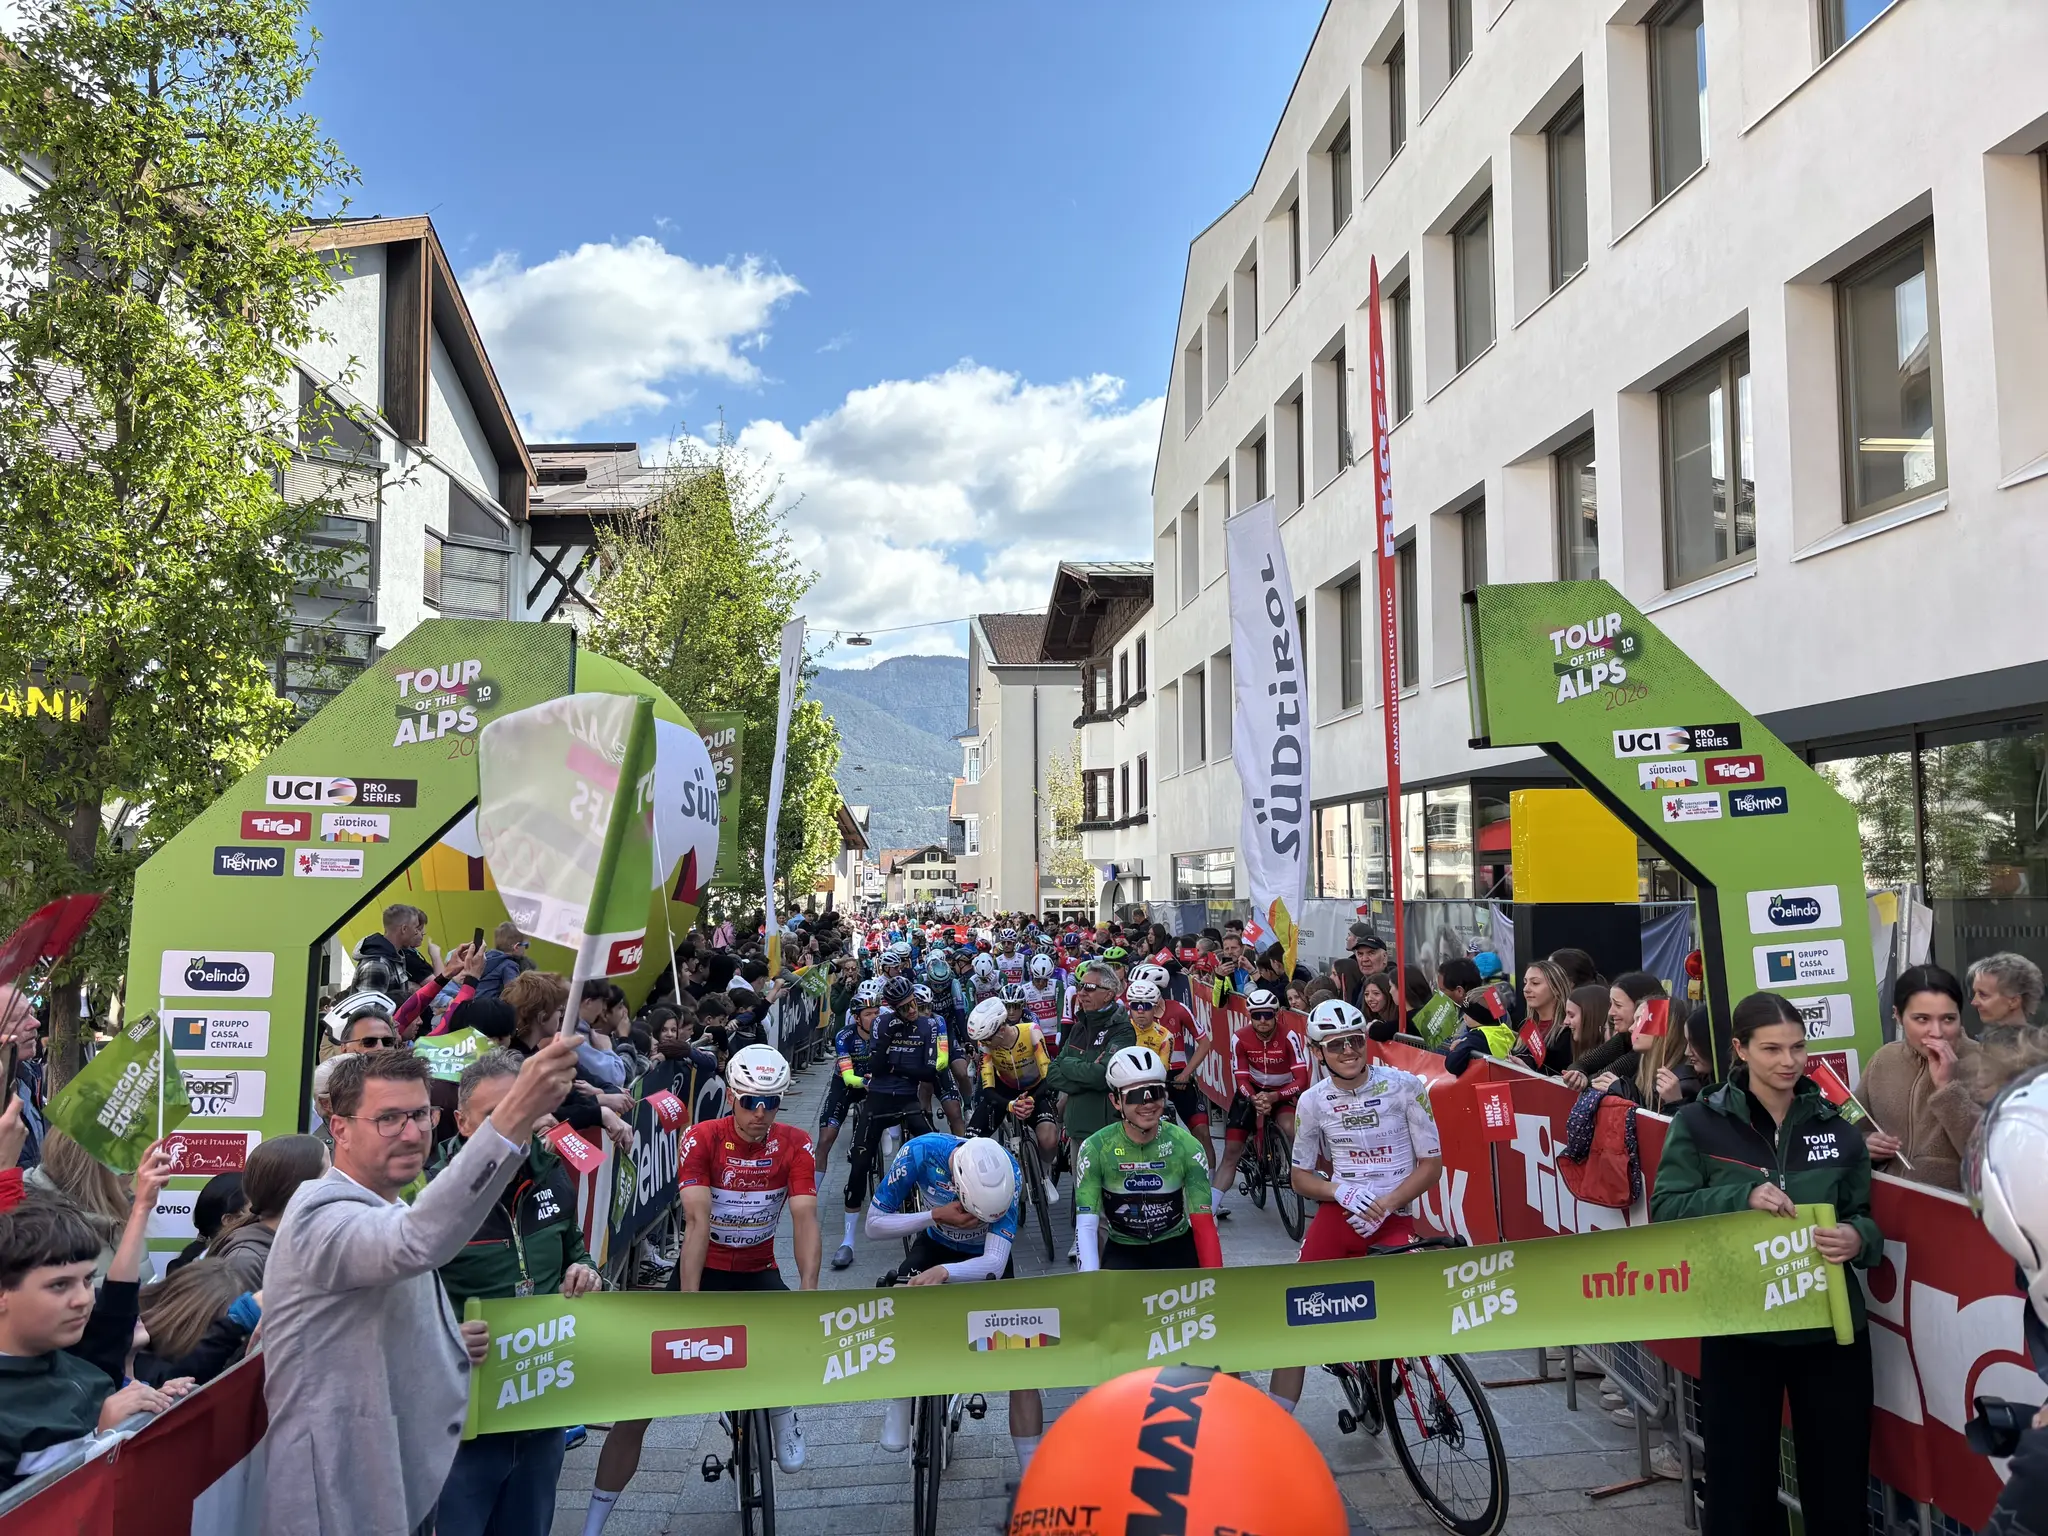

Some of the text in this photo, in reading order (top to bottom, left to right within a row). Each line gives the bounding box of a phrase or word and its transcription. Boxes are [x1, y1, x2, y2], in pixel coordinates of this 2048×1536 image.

[1550, 612, 1622, 656] TOUR
[1621, 637, 1633, 648] 10
[1570, 648, 1605, 667] OF THE
[396, 660, 482, 698] TOUR
[1556, 656, 1626, 704] ALPS
[477, 686, 491, 697] 10
[1605, 681, 1648, 711] 2026
[416, 694, 457, 711] OF THE
[393, 705, 478, 748] ALPS
[1695, 729, 1714, 738] PRO
[703, 728, 736, 750] OUR
[1618, 732, 1661, 752] UCI
[1696, 737, 1728, 748] SERIES
[448, 737, 476, 760] 20
[1649, 764, 1687, 775] SÜDtiROL
[1714, 762, 1756, 778] Tirol
[272, 781, 322, 800] UCI
[363, 783, 387, 793] PRO
[363, 792, 401, 803] SERIES
[1735, 796, 1782, 812] TRENTINO
[252, 818, 302, 836] Tirol
[334, 816, 378, 828] SÜDtiROL
[221, 855, 278, 871] TRENTINO
[1770, 902, 1819, 918] Melinda
[619, 947, 643, 965] Tiro
[1798, 950, 1828, 958] GRUPPO
[1800, 960, 1822, 968] CASSA
[1800, 968, 1835, 978] CENTRALE
[188, 968, 246, 982] Melinda
[212, 1020, 249, 1028] GRUPPO
[426, 1036, 477, 1058] TOUR
[429, 1064, 470, 1074] ALP
[1248, 1056, 1284, 1064] AUSTRIA
[97, 1062, 141, 1128] EUREGIO
[186, 1082, 232, 1095] FORST
[661, 1098, 678, 1122] BRUCK
[1484, 1103, 1494, 1128] INNS'
[1491, 1095, 1504, 1126] BRUCK
[1502, 1103, 1510, 1126] REGION
[1344, 1116, 1374, 1126] FORST
[185, 1138, 246, 1146] CAFFÈ ITALIANO
[562, 1136, 588, 1160] BRUCK
[568, 1132, 589, 1150] INNS'
[1158, 1140, 1172, 1150] TOUR
[1803, 1134, 1836, 1145] TOUR
[764, 1146, 779, 1156] ALPS
[1158, 1148, 1172, 1158] ALPS
[1807, 1148, 1840, 1162] ALPS
[888, 1166, 908, 1186] ALPS
[1126, 1178, 1162, 1188] Melinda
[533, 1188, 554, 1200] TOUR
[156, 1205, 190, 1214] eviso
[538, 1203, 561, 1221] ALPS
[1141, 1200, 1174, 1211] ANEST
[1145, 1206, 1174, 1219] IWATA
[1443, 1249, 1514, 1290] TOUR
[1776, 1257, 1810, 1276] OF THE
[1142, 1278, 1216, 1317] TOUR
[1462, 1280, 1497, 1300] OF THE
[1764, 1266, 1828, 1312] ALPS
[1294, 1293, 1368, 1318] TRENTINO
[1451, 1288, 1518, 1335] ALPS
[819, 1296, 894, 1338] TOUR
[984, 1313, 1044, 1328] SÜDtiROL
[1161, 1307, 1197, 1326] OF THE
[495, 1314, 577, 1361] TOUR
[839, 1328, 876, 1348] OF THE
[1146, 1314, 1217, 1360] ALPS
[666, 1336, 733, 1362] Tirol
[515, 1352, 554, 1372] OF THE
[822, 1336, 896, 1386] ALPS
[496, 1360, 575, 1410] ALPS
[1011, 1506, 1101, 1535] SPRINT
